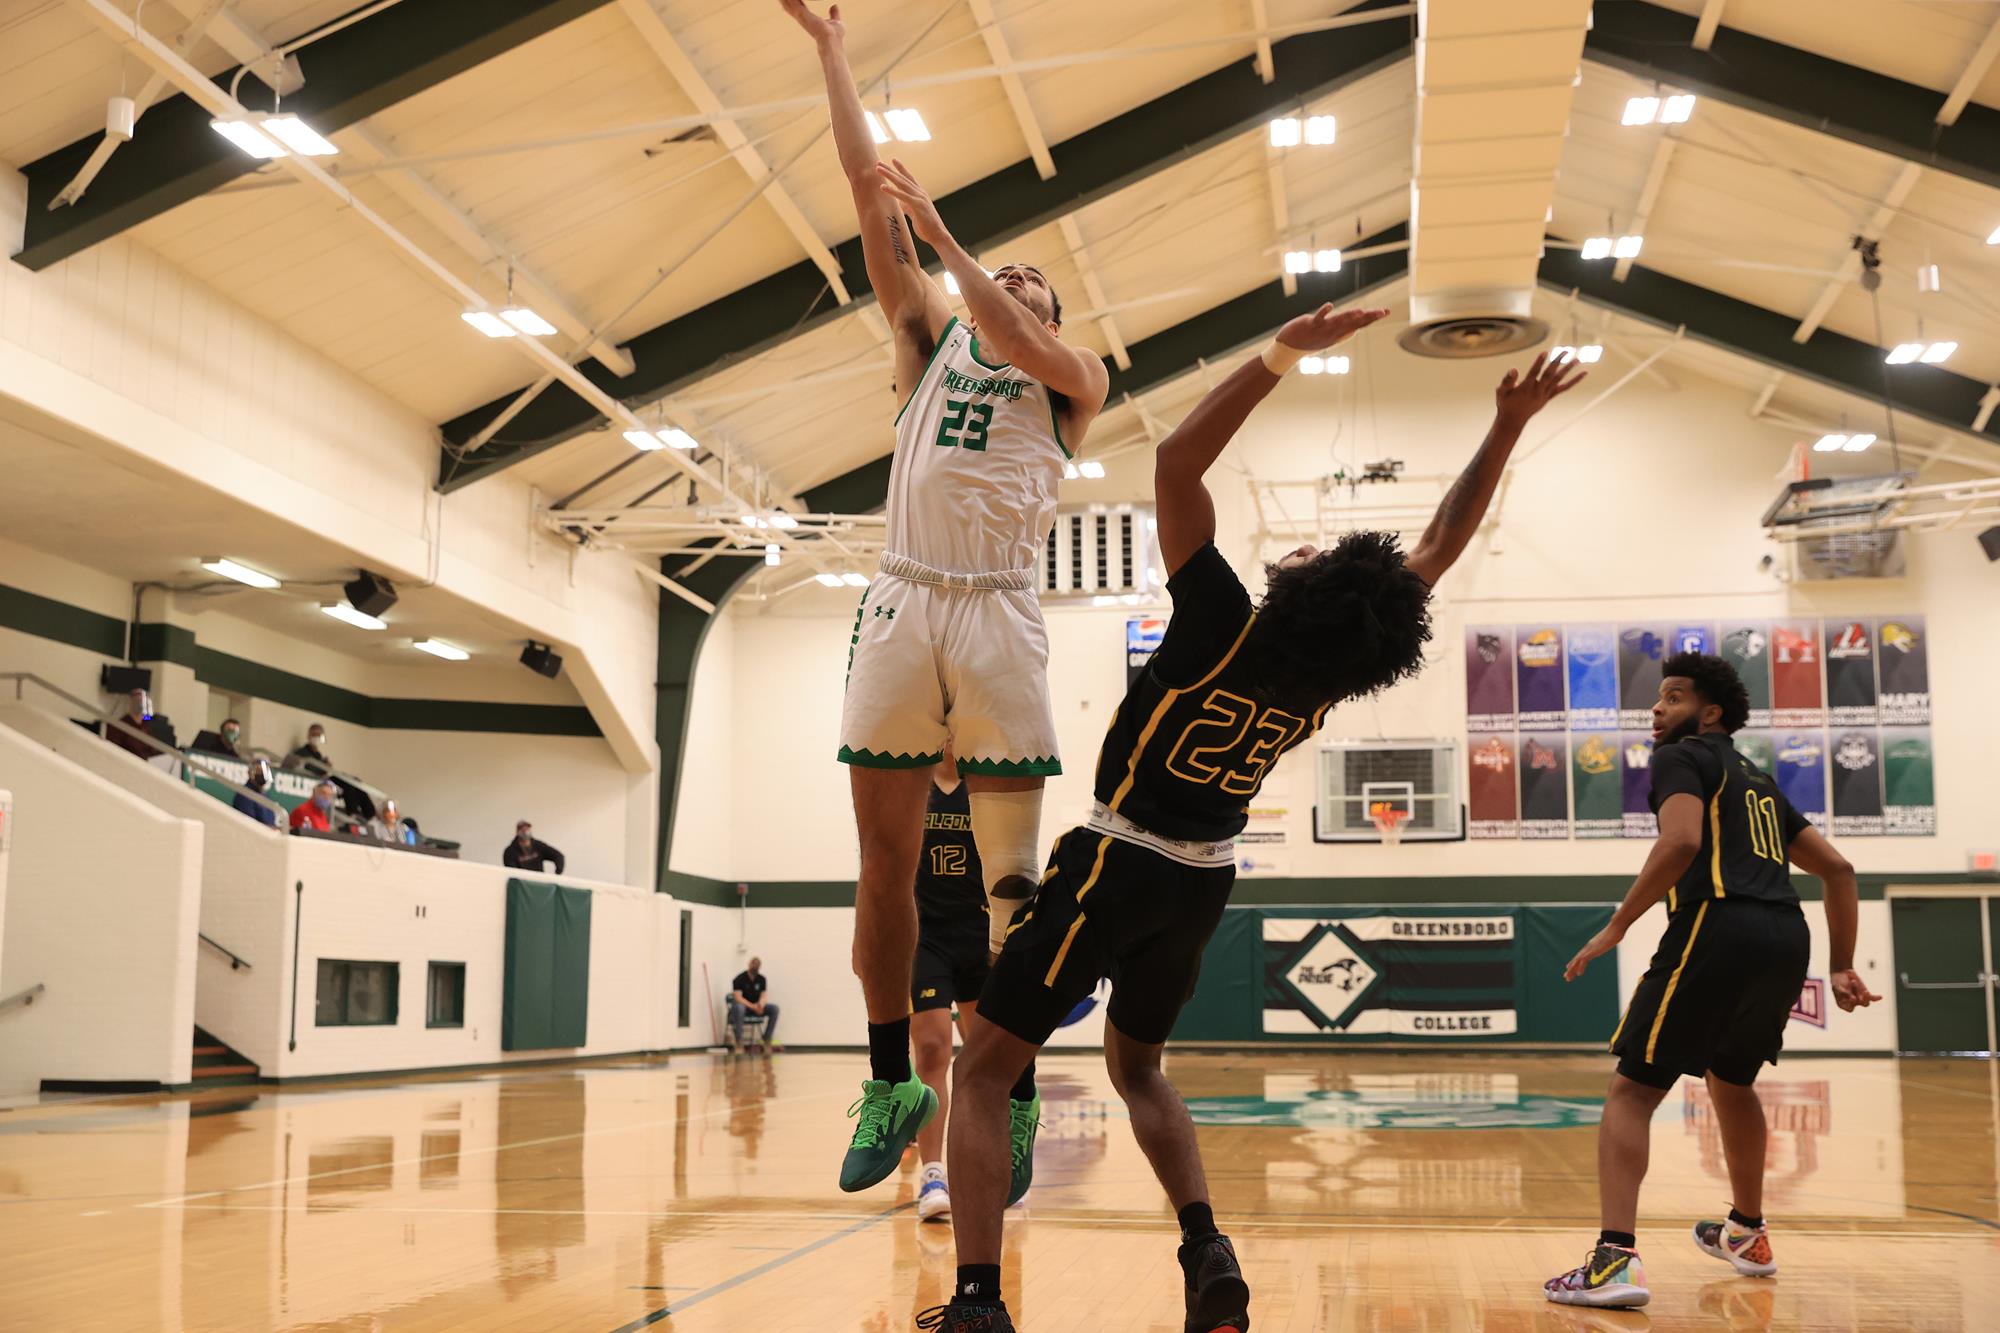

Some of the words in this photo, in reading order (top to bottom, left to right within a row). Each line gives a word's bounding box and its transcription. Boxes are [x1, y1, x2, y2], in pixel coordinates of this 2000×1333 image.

[942, 367, 1026, 401] REENSBORO
[936, 399, 993, 451] 23
[1166, 689, 1306, 794] 23
[925, 813, 971, 831] ALCON
[1745, 789, 1784, 865] 11
[930, 845, 967, 875] 12
[1393, 921, 1508, 936] GREENSBORO
[1413, 1015, 1492, 1031] COLLEGE
